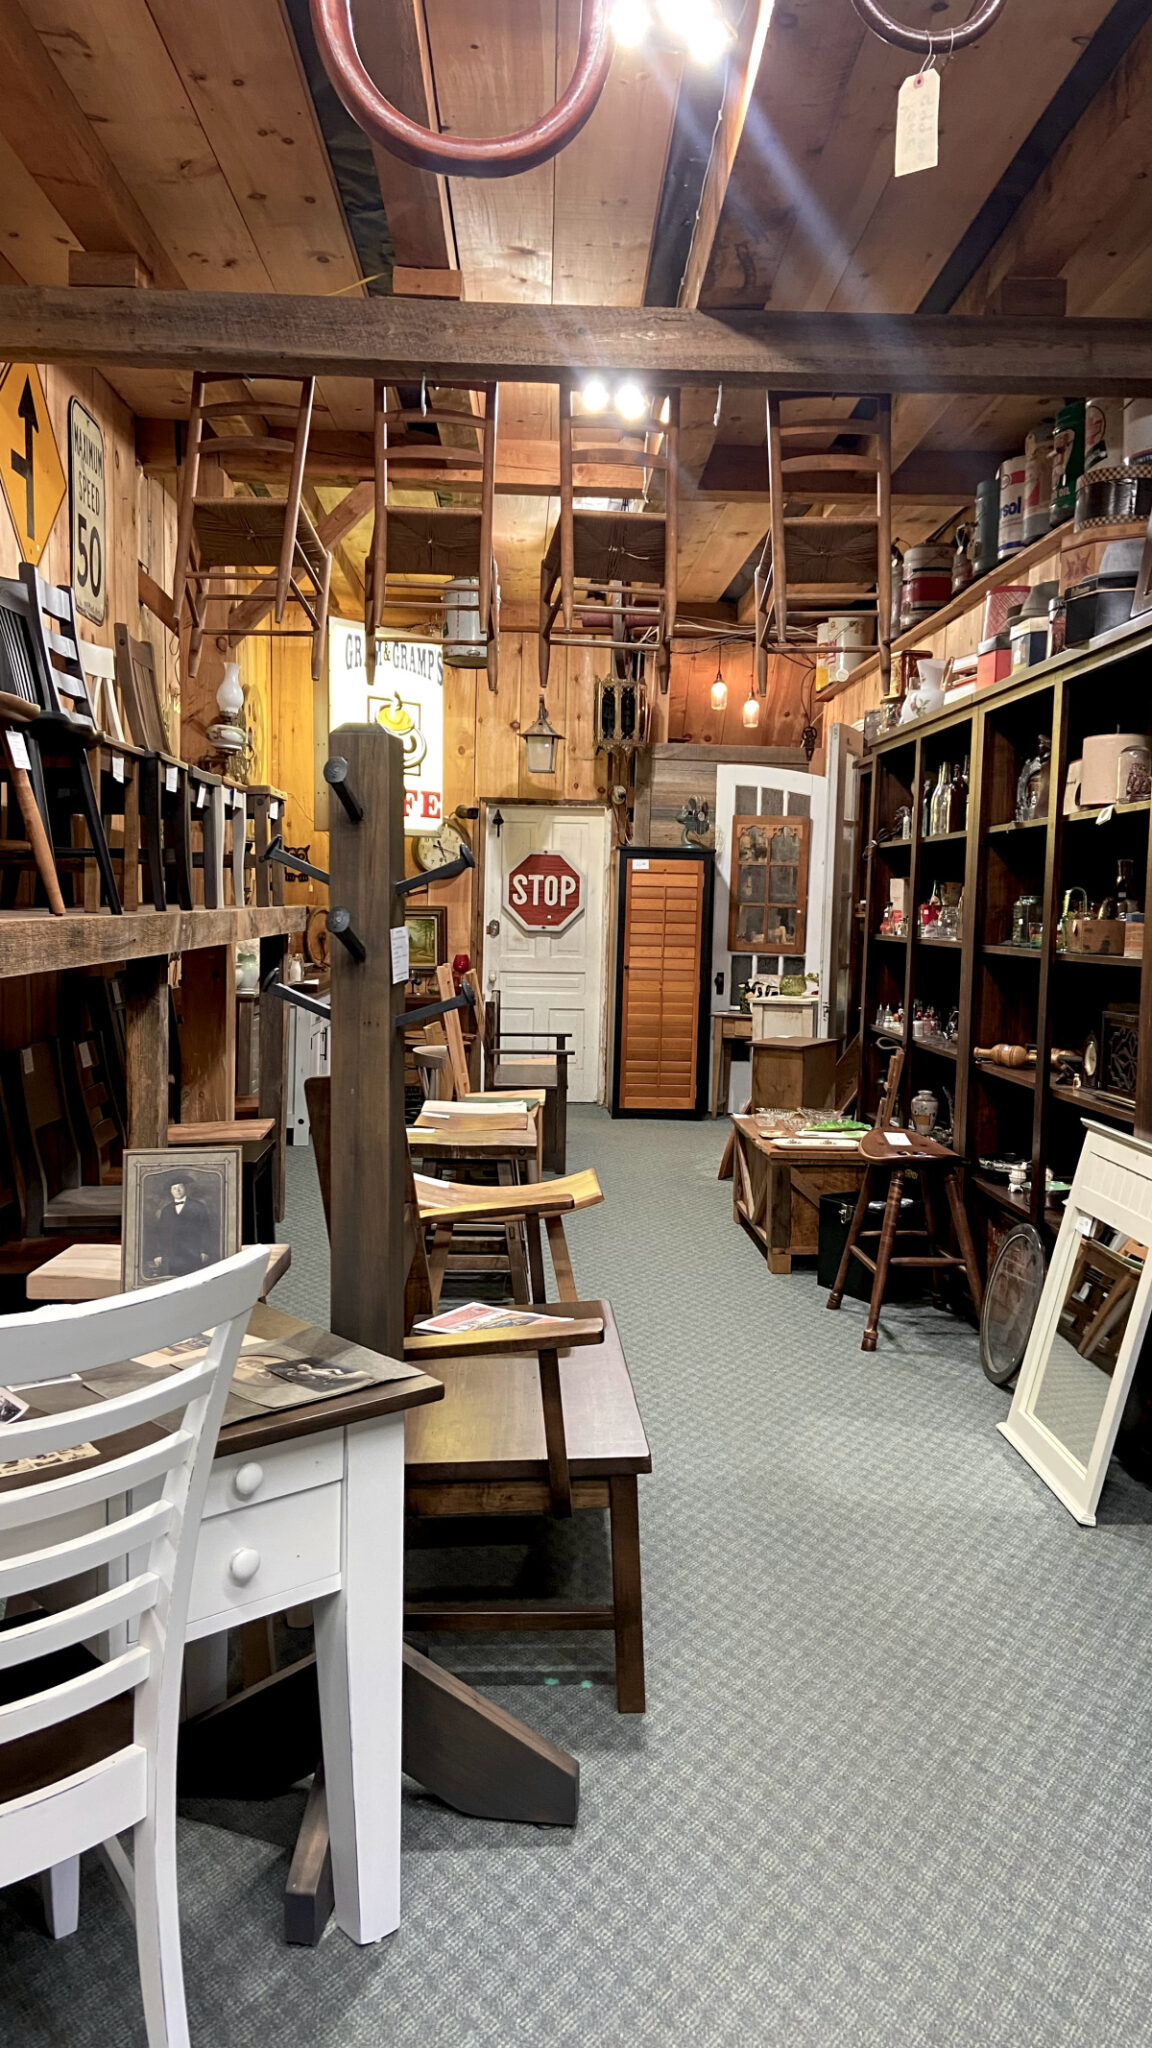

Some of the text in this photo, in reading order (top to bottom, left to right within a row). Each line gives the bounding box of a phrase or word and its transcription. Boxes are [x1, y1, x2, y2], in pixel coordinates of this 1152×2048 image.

[74, 422, 103, 479] MAXIMUM
[79, 470, 100, 516] SPEED
[1001, 496, 1021, 518] sol
[77, 513, 101, 598] 50
[345, 633, 443, 687] GRM & GRAMP'S
[403, 789, 441, 819] FE
[512, 874, 576, 907] STOP
